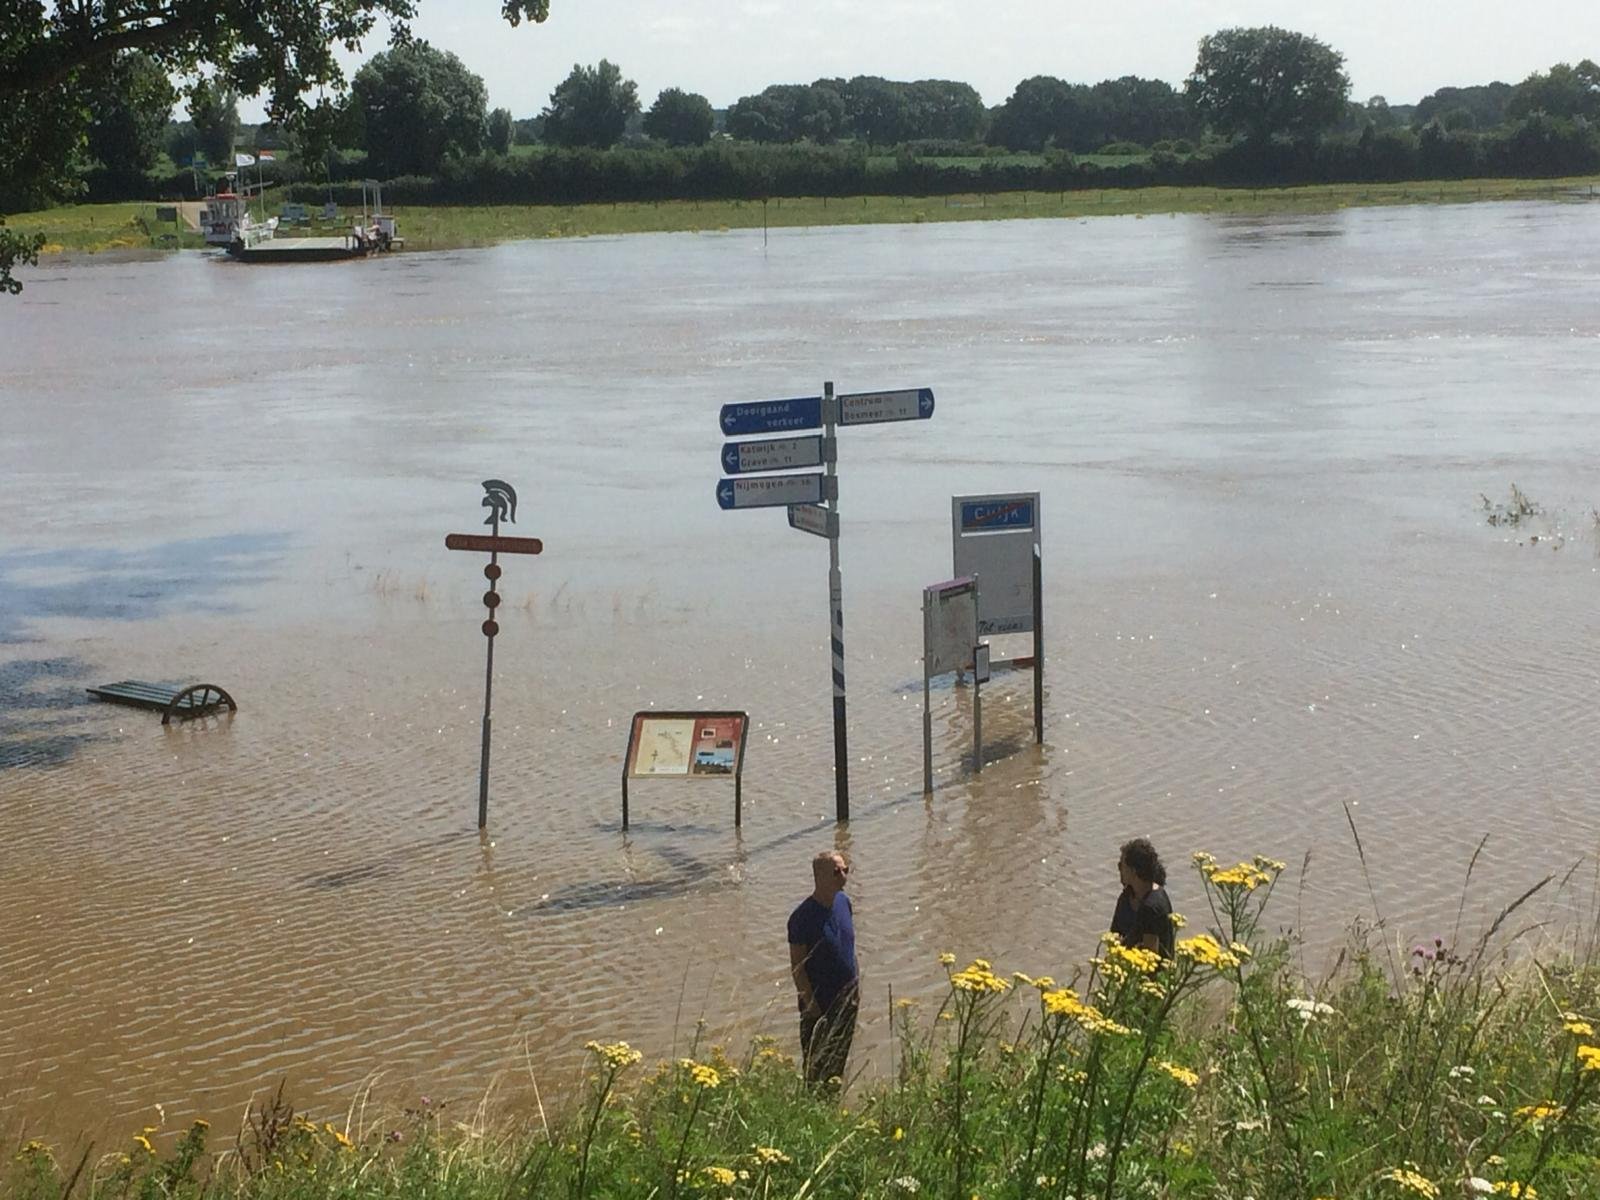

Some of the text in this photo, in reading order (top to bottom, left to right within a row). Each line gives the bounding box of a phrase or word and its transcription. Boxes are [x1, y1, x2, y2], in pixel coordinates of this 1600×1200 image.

[844, 397, 882, 407] Centrum
[736, 403, 790, 417] Doorgaand
[767, 416, 805, 427] verkeer
[740, 443, 775, 455] Katwijk
[741, 457, 767, 467] Grave
[736, 479, 783, 492] Nijmegen
